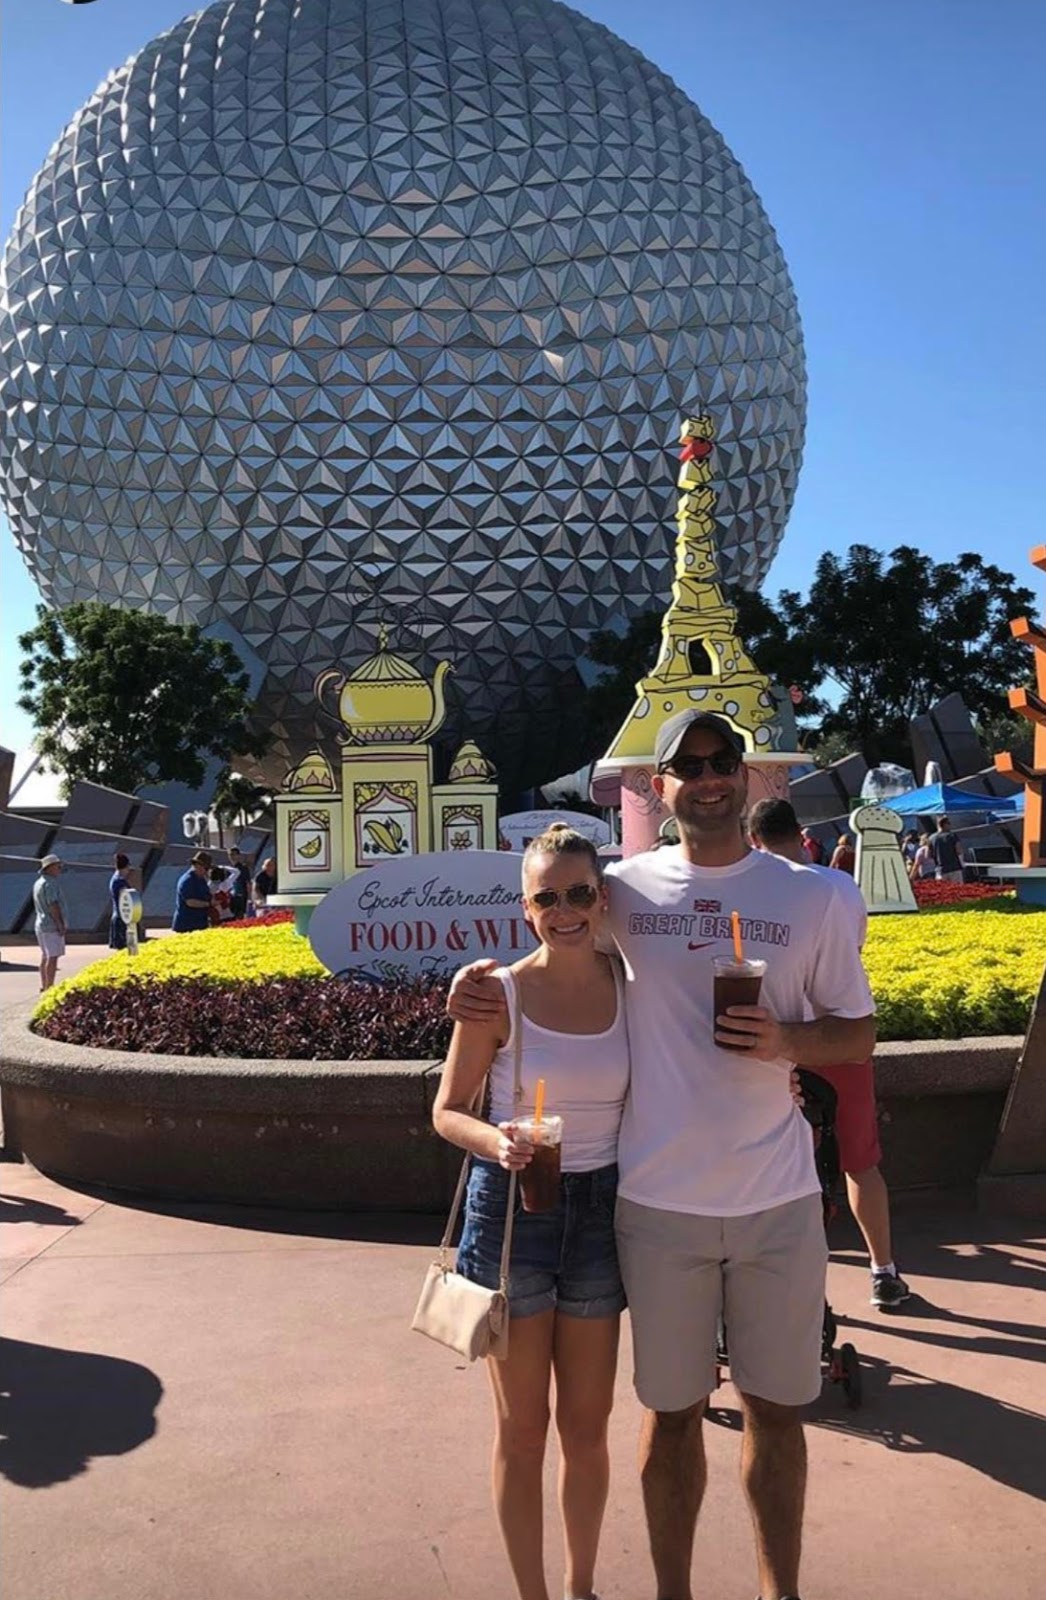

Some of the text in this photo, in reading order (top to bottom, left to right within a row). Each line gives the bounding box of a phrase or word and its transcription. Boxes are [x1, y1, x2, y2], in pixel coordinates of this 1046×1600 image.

[358, 881, 415, 918] Epcot
[348, 921, 437, 952] FOOD
[445, 919, 471, 951] &
[629, 913, 791, 947] GREAT BRTAIN
